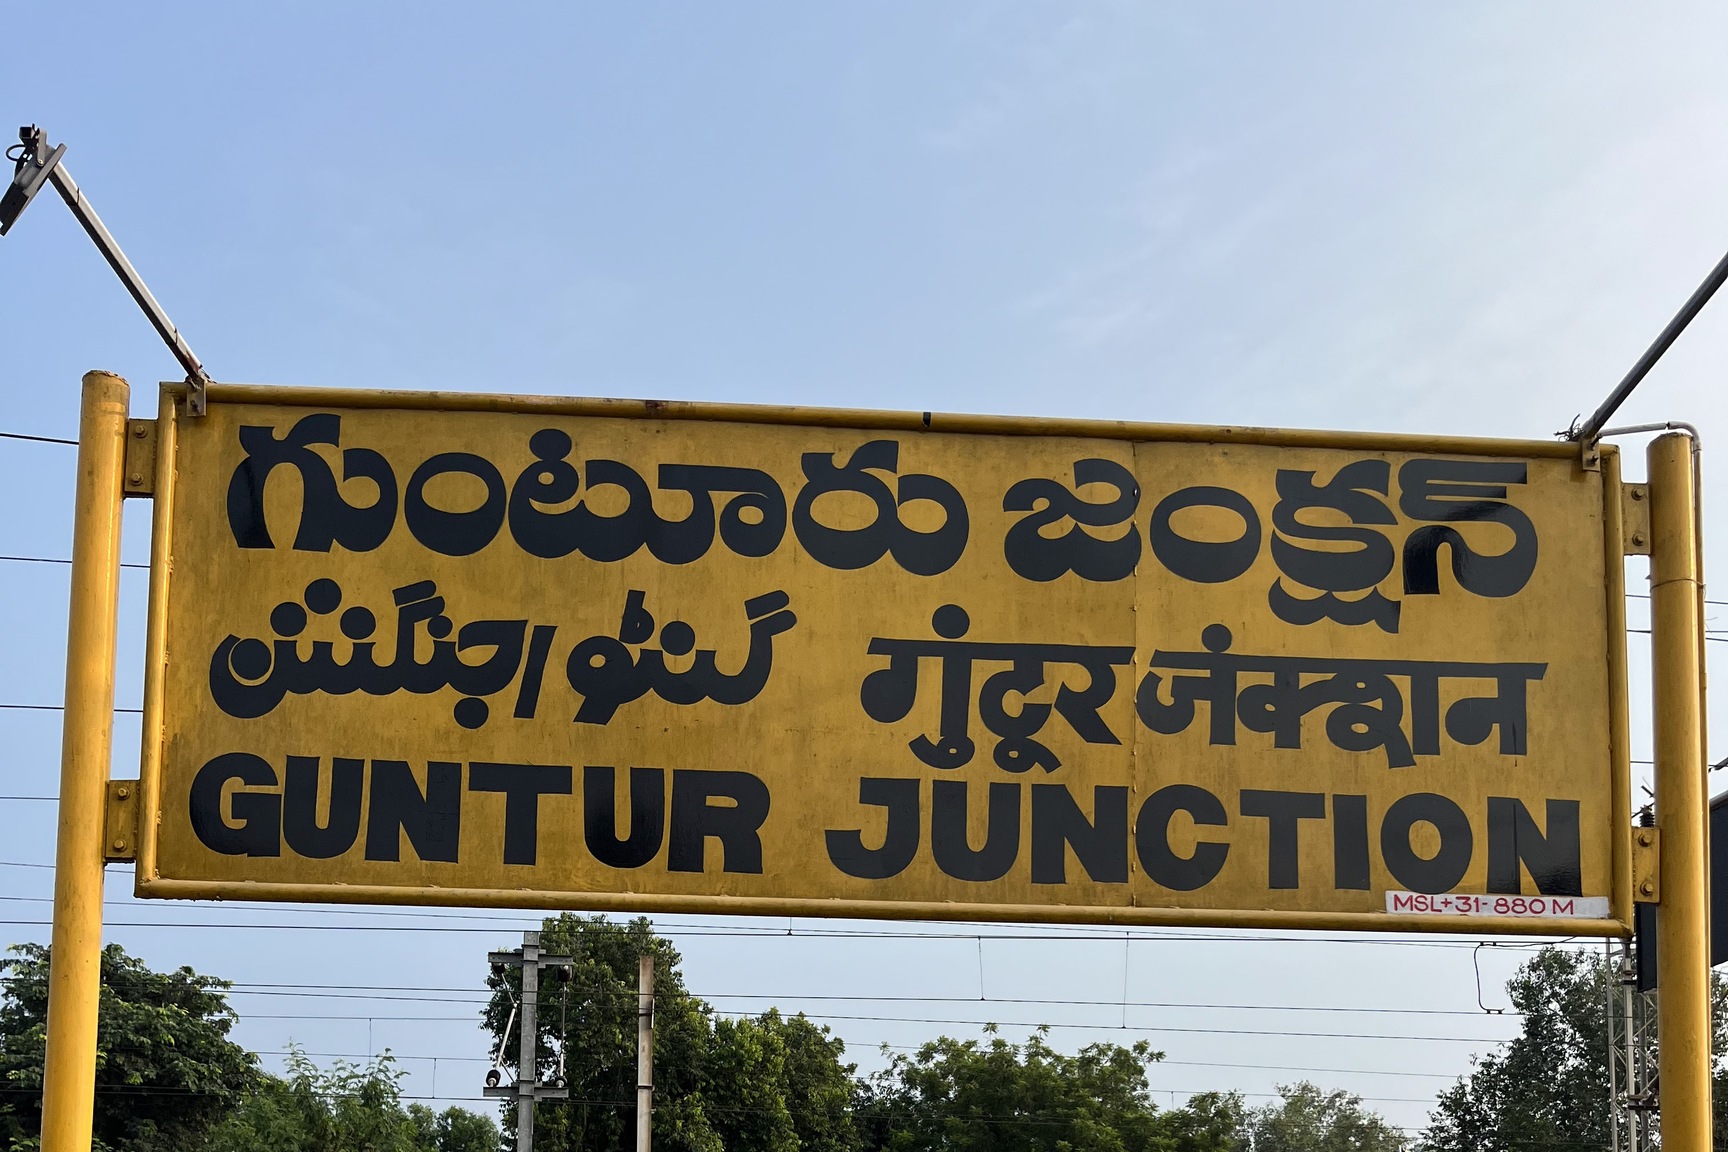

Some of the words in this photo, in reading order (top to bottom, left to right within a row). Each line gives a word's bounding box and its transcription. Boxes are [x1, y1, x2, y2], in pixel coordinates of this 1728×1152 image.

[227, 413, 969, 577] గుంటూరు
[1003, 458, 1538, 633] జంక్షన్
[861, 604, 1134, 773] गुंटूर
[1136, 624, 1548, 769] जंक्शन
[189, 752, 770, 874] GUNTUR
[825, 777, 1583, 897] JUNCTION
